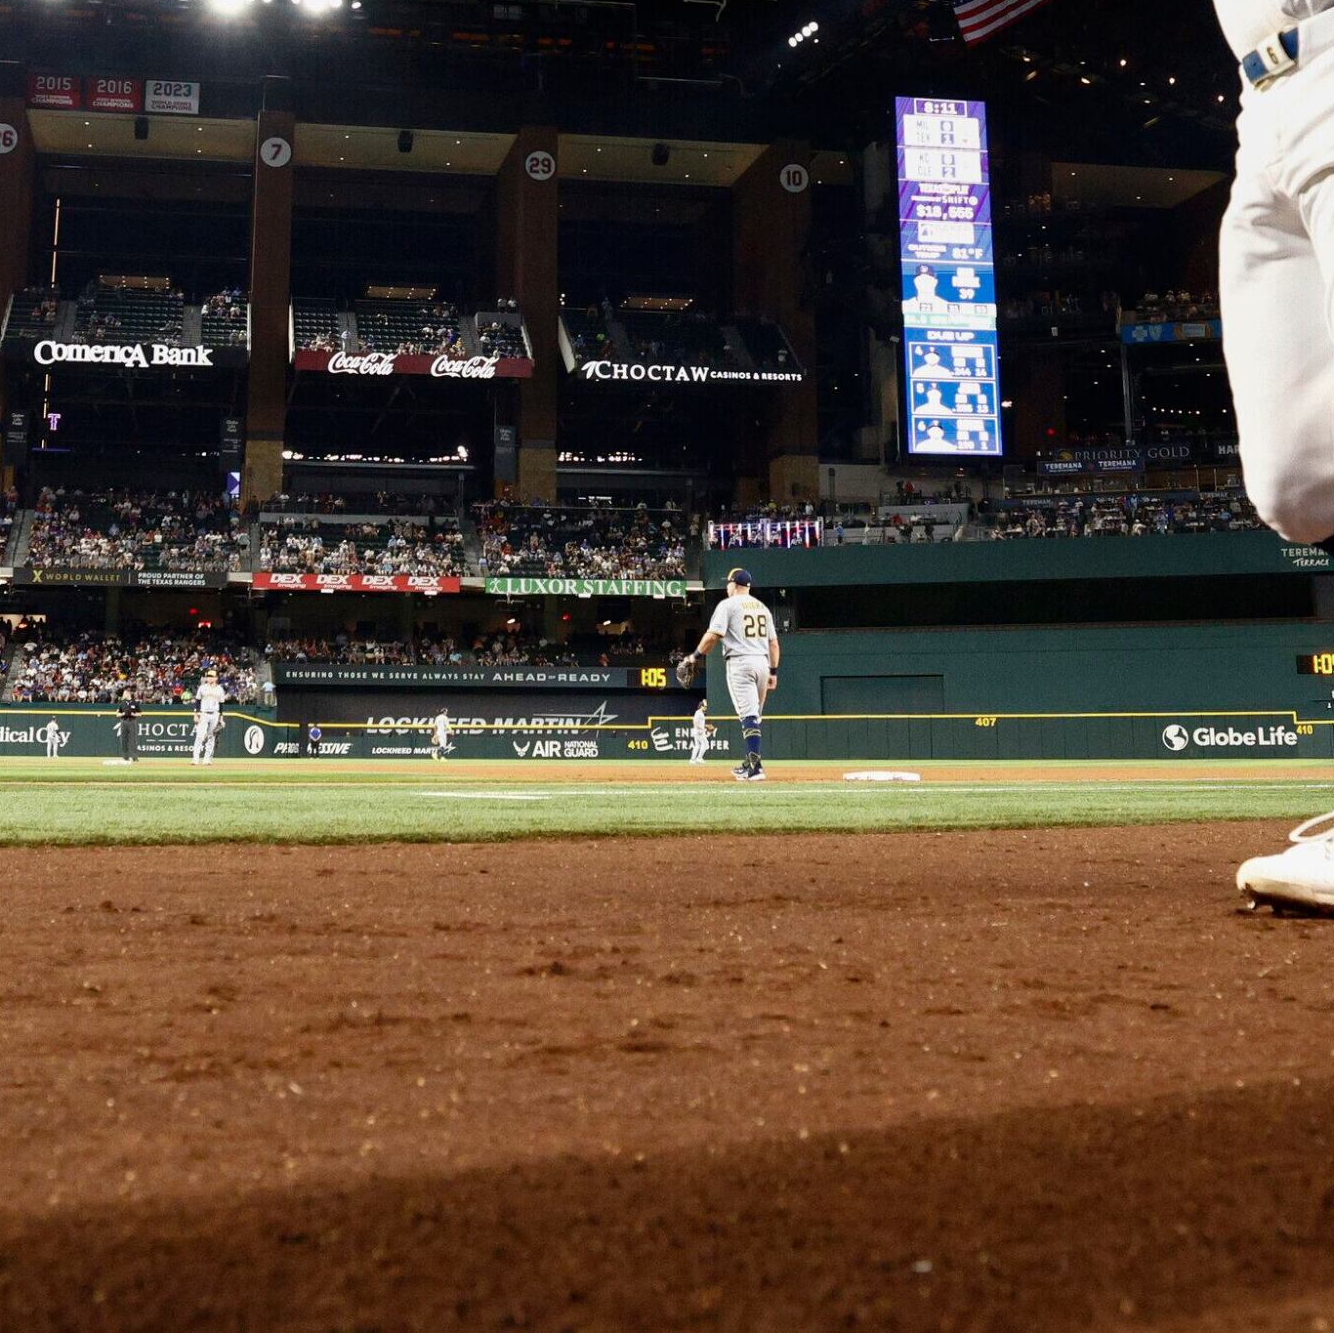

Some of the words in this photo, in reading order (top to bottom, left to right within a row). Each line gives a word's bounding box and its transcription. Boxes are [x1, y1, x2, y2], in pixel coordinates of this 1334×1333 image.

[35, 75, 72, 91] 2015
[96, 79, 133, 95] 2016
[153, 82, 192, 97] 2023
[270, 144, 283, 161] 7
[529, 156, 552, 175] 29
[785, 170, 803, 187] 10
[152, 345, 213, 366] Bank
[594, 359, 710, 382] CHOCTAW
[710, 370, 752, 380] CASINOS
[761, 372, 803, 381] RESORTS
[1075, 450, 1142, 461] PRIORITY
[1147, 446, 1191, 459] GOLD
[45, 573, 84, 582] WORLD
[85, 574, 120, 582] WALLET
[137, 572, 163, 580] PROUD
[163, 572, 194, 580] PARTNER
[137, 578, 151, 586] THE
[152, 578, 173, 586] TEXAS
[174, 579, 206, 587] RANGERS
[270, 573, 303, 584] DEX
[316, 574, 350, 585] DEX
[362, 575, 395, 586] DEX
[407, 576, 441, 587] DEX
[506, 578, 579, 595] LUXOR
[582, 579, 684, 597] STAFFING
[743, 614, 768, 639] 28
[286, 670, 336, 679] ENSURING
[337, 671, 368, 679] THOSE
[371, 672, 385, 680] WE
[389, 672, 418, 680] SERVE
[422, 672, 460, 681] ALWAYS
[462, 672, 486, 681] STAY
[492, 673, 548, 683] AHEAD
[557, 673, 611, 684] READY
[640, 668, 666, 688] 1:05
[492, 717, 582, 735] MARTIN
[974, 717, 998, 728] 407
[1297, 724, 1313, 735] 410
[1193, 727, 1256, 748] Globe
[1257, 726, 1298, 748] Life
[372, 747, 413, 755] LOCKHEED
[532, 740, 562, 758] AIR
[564, 741, 598, 749] NATIONAL
[627, 740, 648, 751] 410
[563, 748, 599, 758] GUARD
